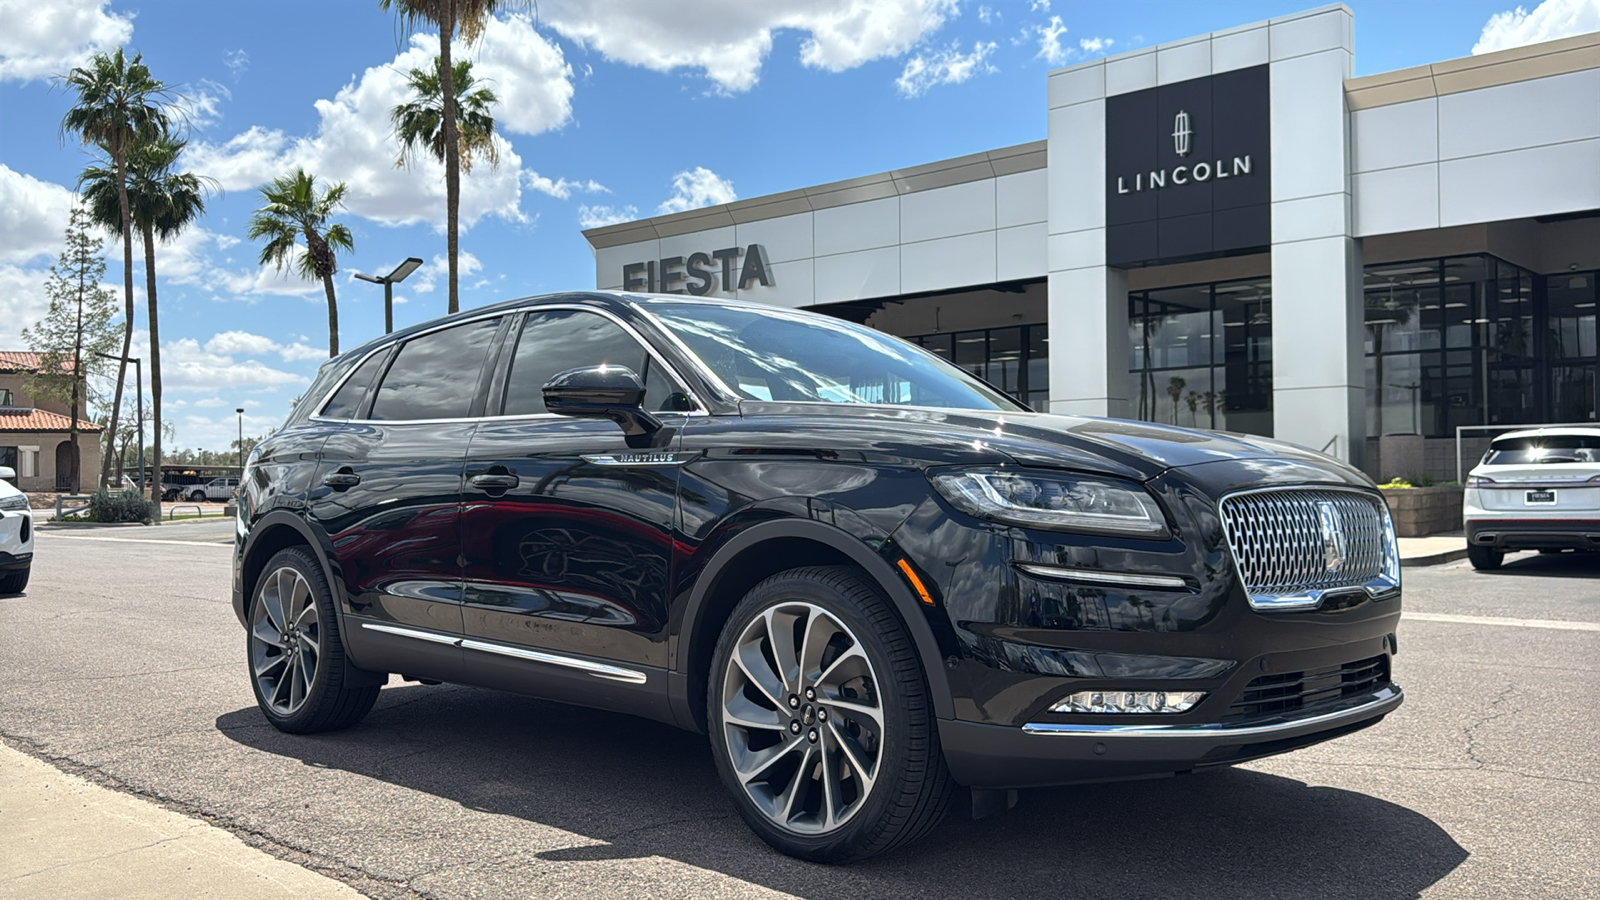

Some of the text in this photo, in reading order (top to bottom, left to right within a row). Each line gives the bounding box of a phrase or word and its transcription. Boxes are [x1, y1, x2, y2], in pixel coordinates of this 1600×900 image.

[1118, 155, 1251, 194] LINCOLN
[623, 244, 775, 296] FIESTA
[620, 453, 674, 463] NAUTILUS
